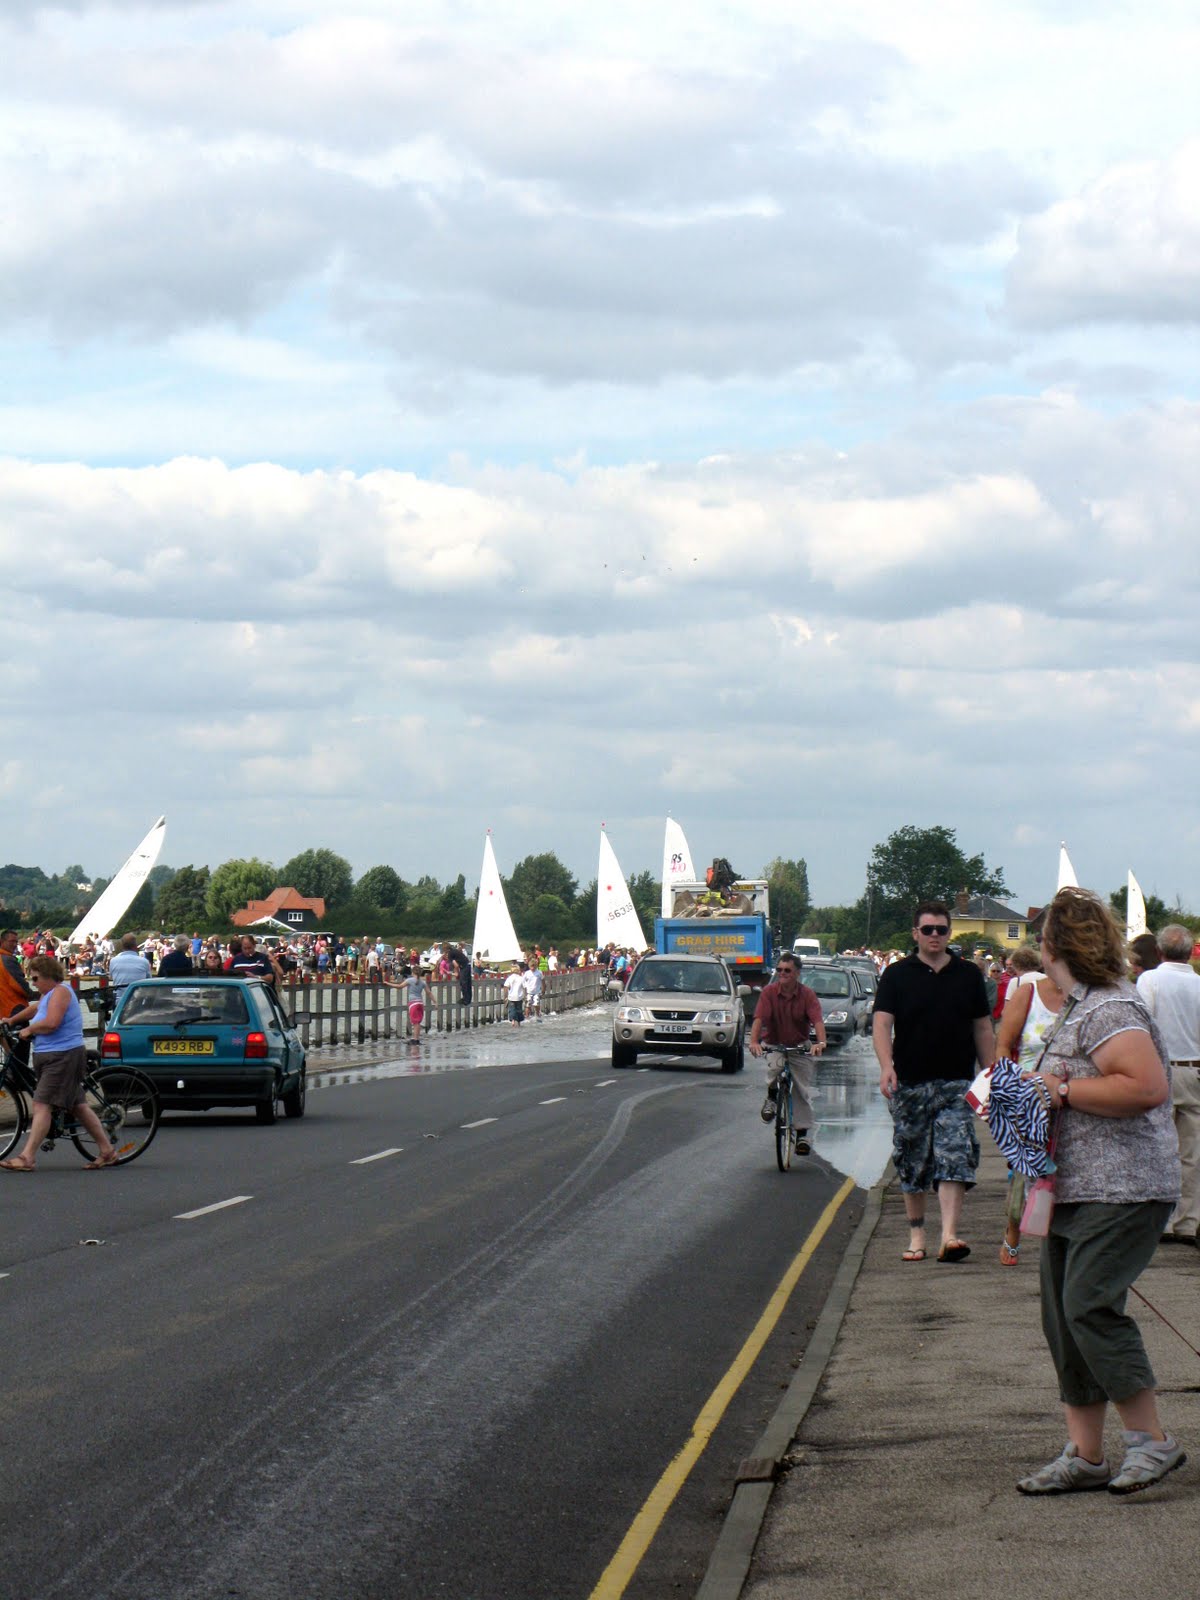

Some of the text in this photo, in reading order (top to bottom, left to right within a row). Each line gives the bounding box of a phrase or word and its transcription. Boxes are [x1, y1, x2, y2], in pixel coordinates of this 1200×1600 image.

[671, 853, 683, 864] RS
[677, 935, 745, 946] GRAB HIRE
[155, 1041, 213, 1052] K493 RBJ
